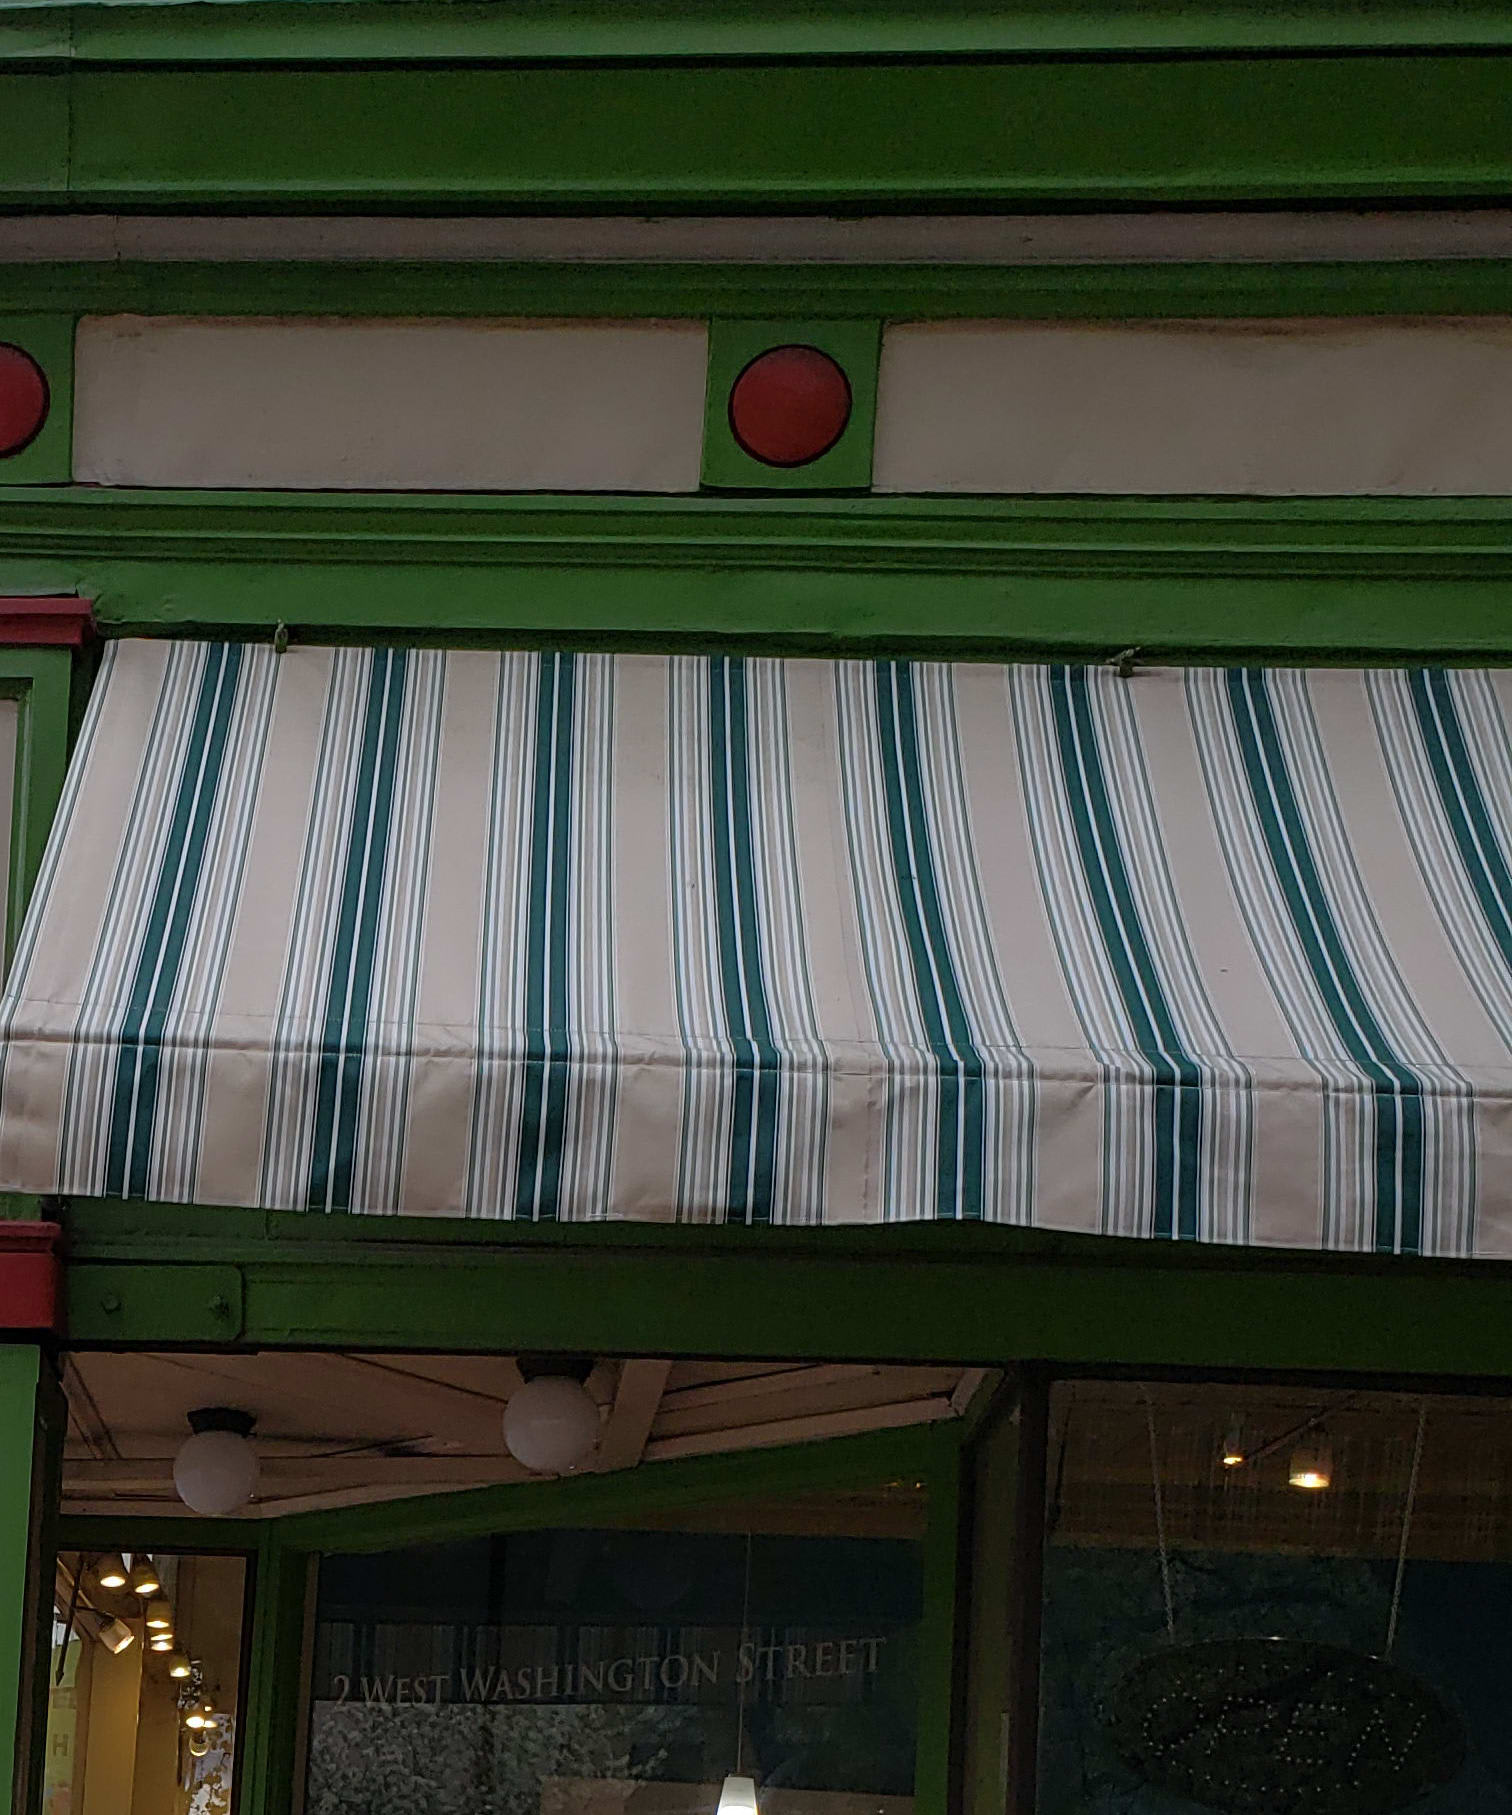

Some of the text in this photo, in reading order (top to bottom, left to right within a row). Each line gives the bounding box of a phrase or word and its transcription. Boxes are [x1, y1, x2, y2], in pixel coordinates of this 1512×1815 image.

[361, 1674, 450, 1704] WEST
[460, 1649, 722, 1701] WASHINGTON
[735, 1636, 888, 1685] STREET
